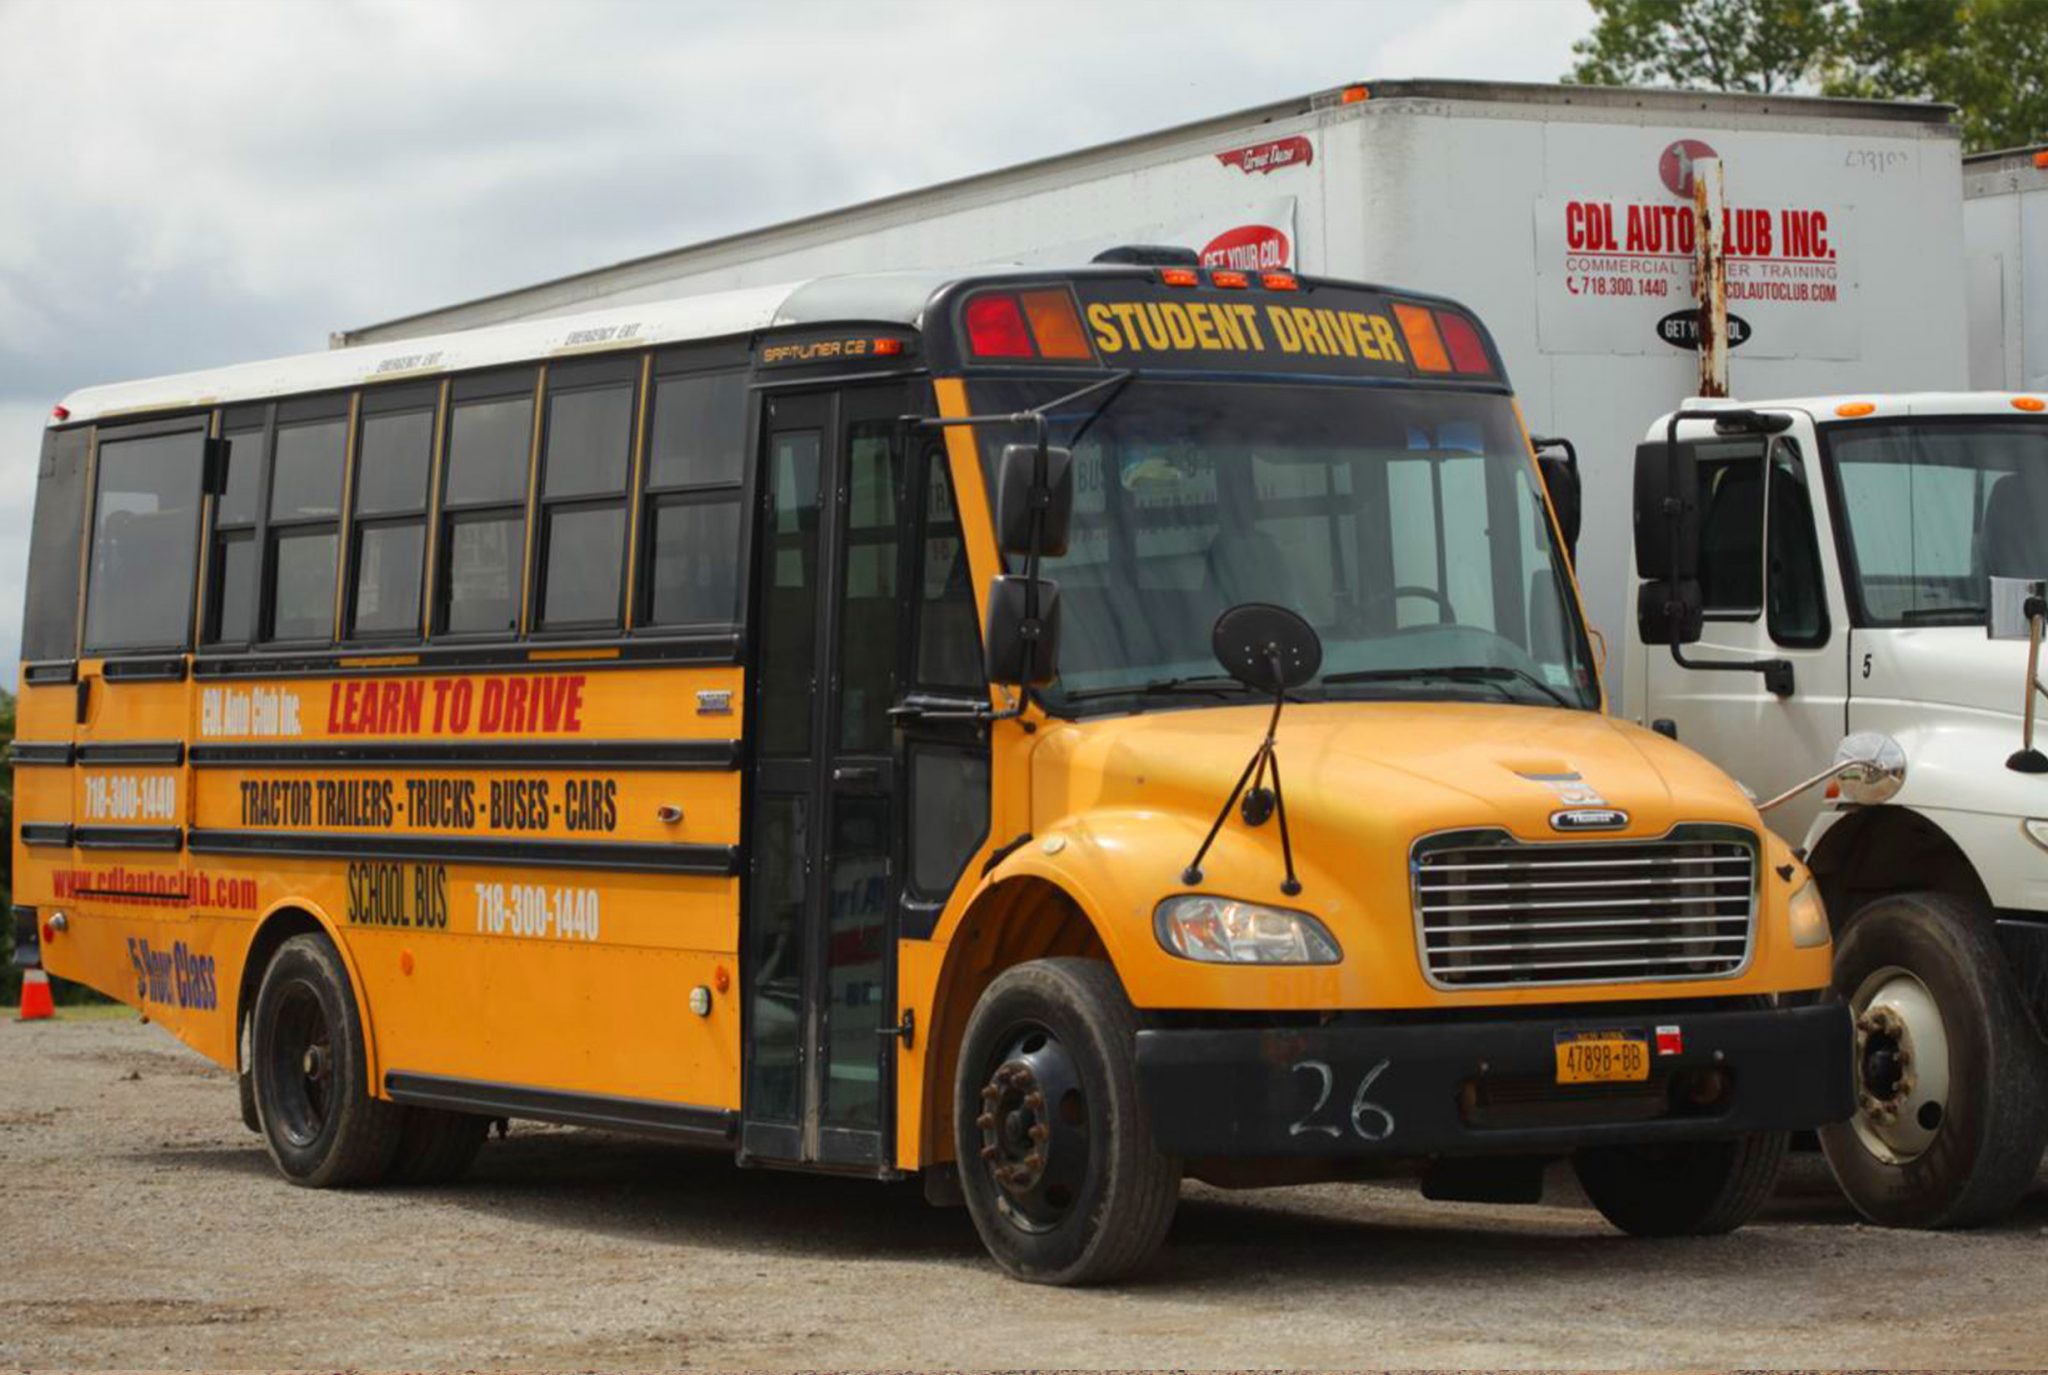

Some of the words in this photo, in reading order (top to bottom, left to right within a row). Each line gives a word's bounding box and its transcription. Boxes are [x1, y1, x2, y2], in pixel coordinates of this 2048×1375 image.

[1566, 201, 1619, 251] CDL
[1626, 204, 1695, 254] AUTO
[1721, 207, 1773, 256] LUB
[1781, 209, 1836, 258] INC.
[1566, 258, 1679, 275] COMMERCIAL
[1760, 263, 1838, 281] TRAINING
[1581, 275, 1668, 298] 718.300.1440
[1087, 302, 1264, 353] STUDENT
[1266, 305, 1405, 363] DRIVER
[1664, 319, 1687, 339] GET
[1862, 652, 1872, 680] 5
[327, 680, 426, 735] LEARN
[433, 677, 473, 734] TO
[478, 675, 587, 733] DRIVE
[84, 775, 176, 820] 718-300-1440
[240, 780, 312, 827] TRACTOR
[316, 779, 394, 827] TRAILERS
[406, 779, 476, 829] TRUCKS
[489, 779, 550, 830] BUSES
[564, 779, 617, 832] CARS
[347, 861, 410, 927] SCHOOL
[413, 862, 447, 929] BUS
[475, 882, 600, 942] 718-300-1440
[174, 940, 217, 1011] Class
[1289, 1058, 1395, 1141] 26
